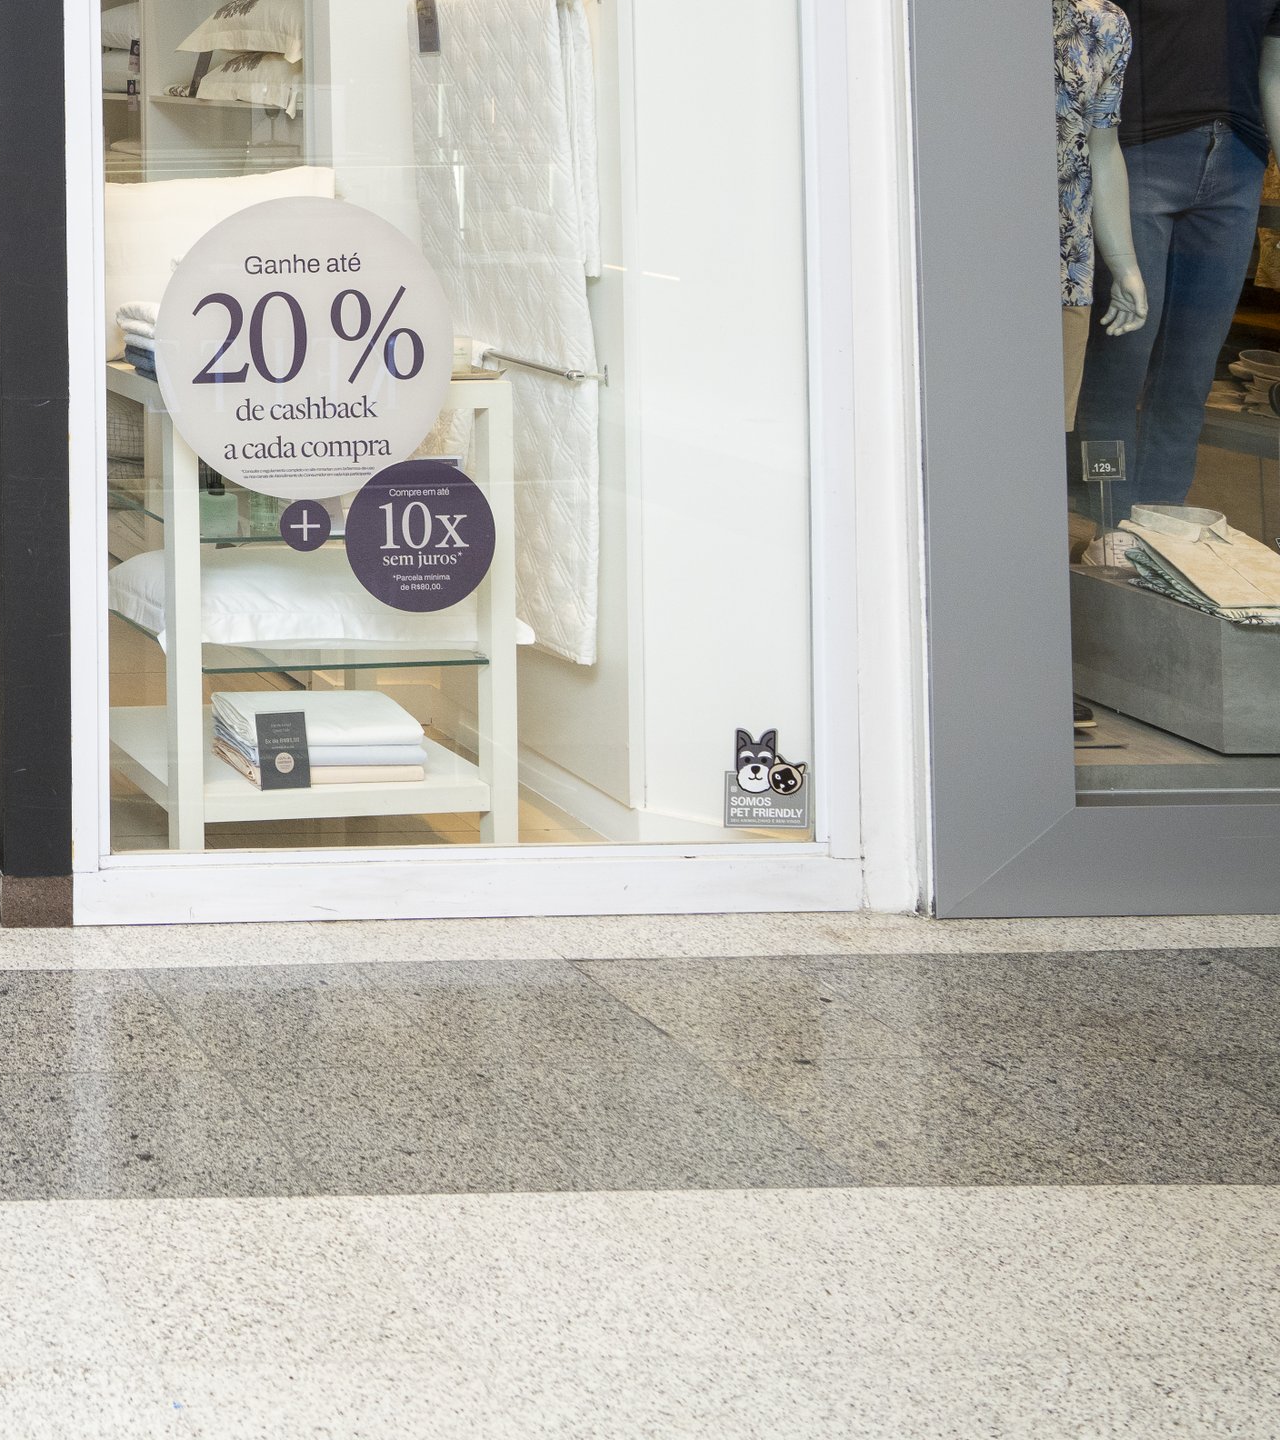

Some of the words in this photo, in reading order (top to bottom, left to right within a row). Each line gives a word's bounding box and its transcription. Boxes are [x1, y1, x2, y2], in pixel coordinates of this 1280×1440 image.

[244, 253, 321, 275] Ganhe
[326, 252, 362, 273] até
[191, 290, 308, 385] 20
[330, 285, 425, 385] %
[235, 398, 265, 422] de
[269, 395, 379, 421] cashback
[223, 441, 239, 461] a
[242, 435, 295, 460] cada
[301, 437, 392, 464] compra
[389, 488, 423, 498] Compre
[436, 488, 450, 497] até
[378, 501, 470, 550] 10x
[382, 554, 414, 567] sem
[423, 573, 451, 582] mínima
[400, 583, 410, 591] de
[730, 796, 772, 807] SOMOS
[730, 807, 751, 817] PET
[752, 808, 804, 818] FRIENDLY
